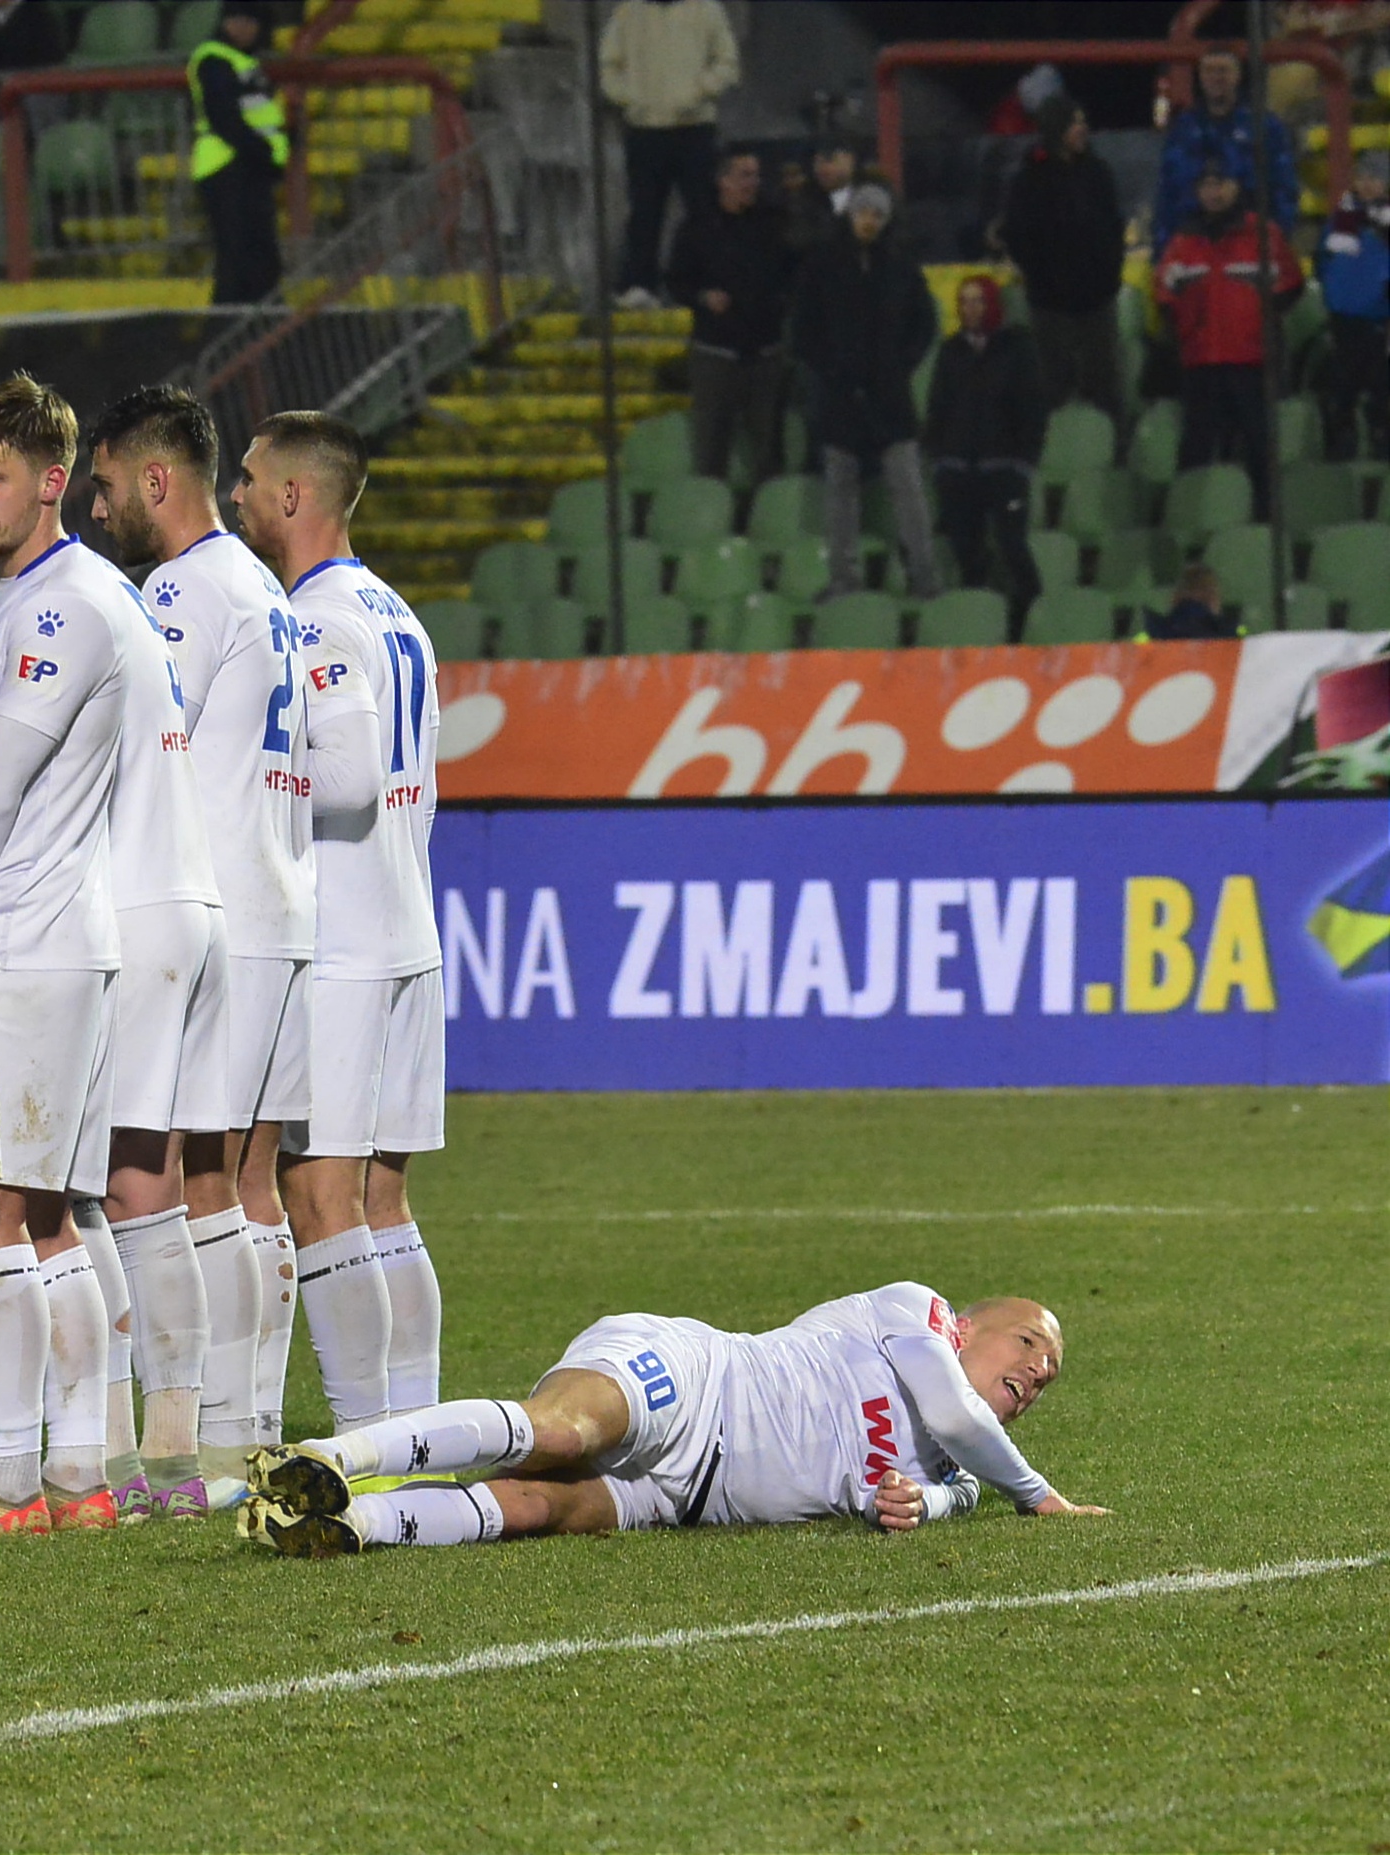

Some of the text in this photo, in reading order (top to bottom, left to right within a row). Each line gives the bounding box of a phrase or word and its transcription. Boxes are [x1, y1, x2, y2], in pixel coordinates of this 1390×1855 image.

[18, 654, 59, 683] EP
[310, 663, 349, 692] EP
[382, 631, 426, 775] 17
[610, 876, 1277, 1019] ZMAJEVI.BA
[626, 1350, 677, 1412] 90
